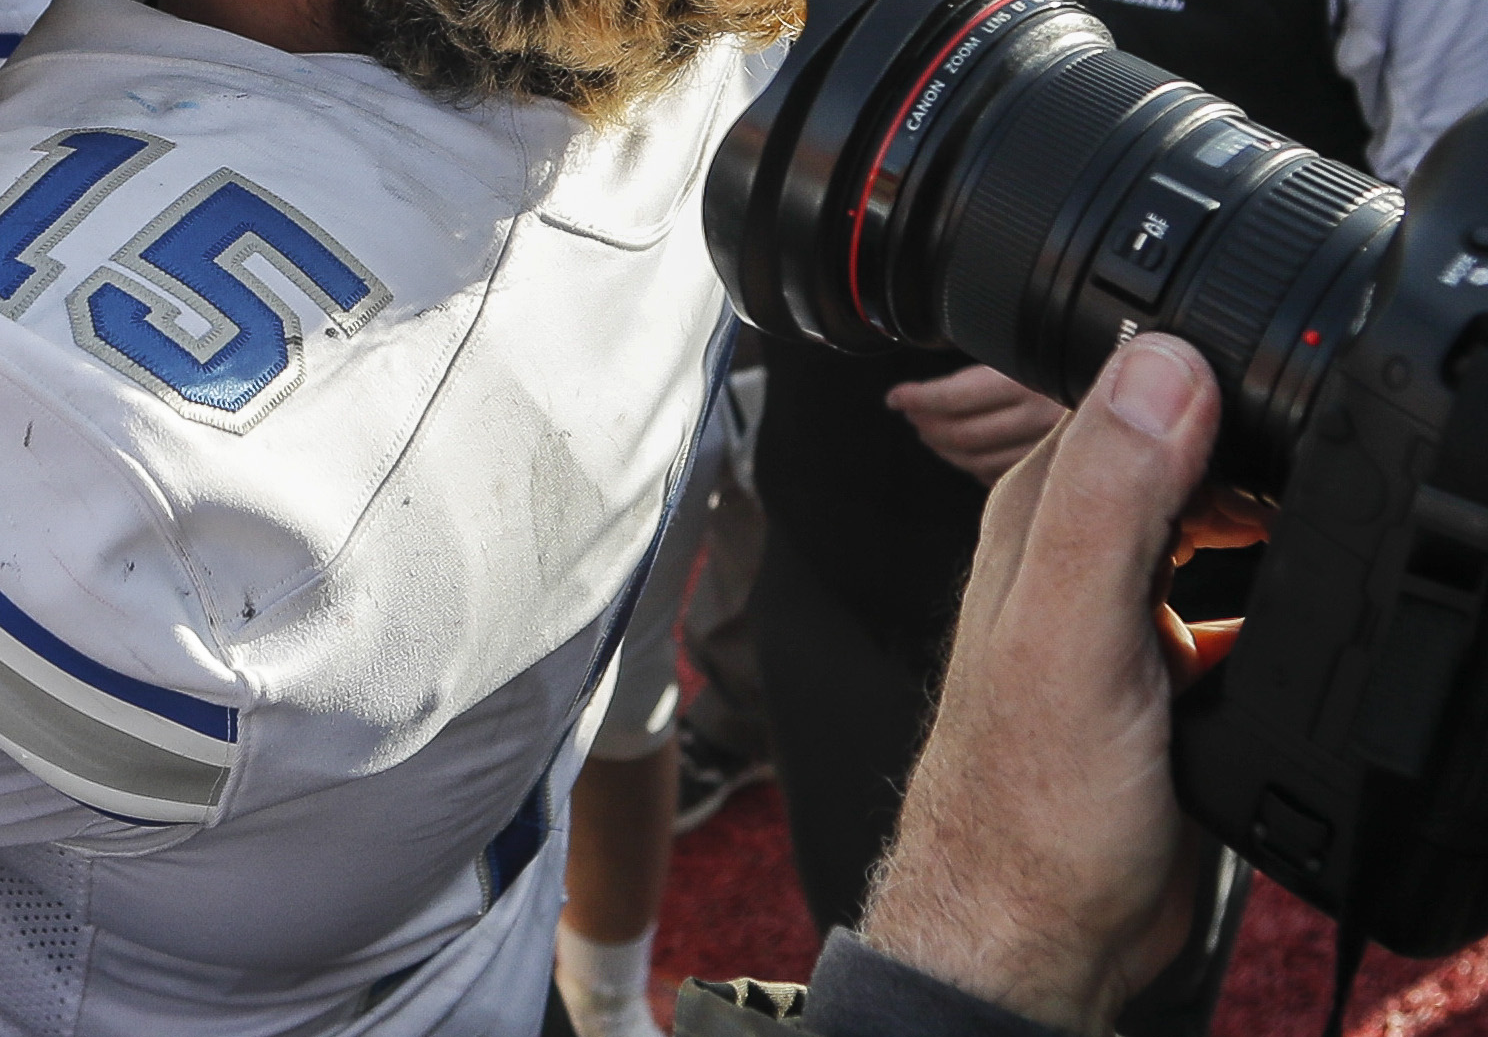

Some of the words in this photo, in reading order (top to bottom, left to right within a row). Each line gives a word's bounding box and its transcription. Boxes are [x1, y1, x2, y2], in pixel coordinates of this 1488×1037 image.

[906, 79, 946, 131] CANON
[943, 36, 982, 74] ZOOM
[981, 11, 1012, 34] LENS
